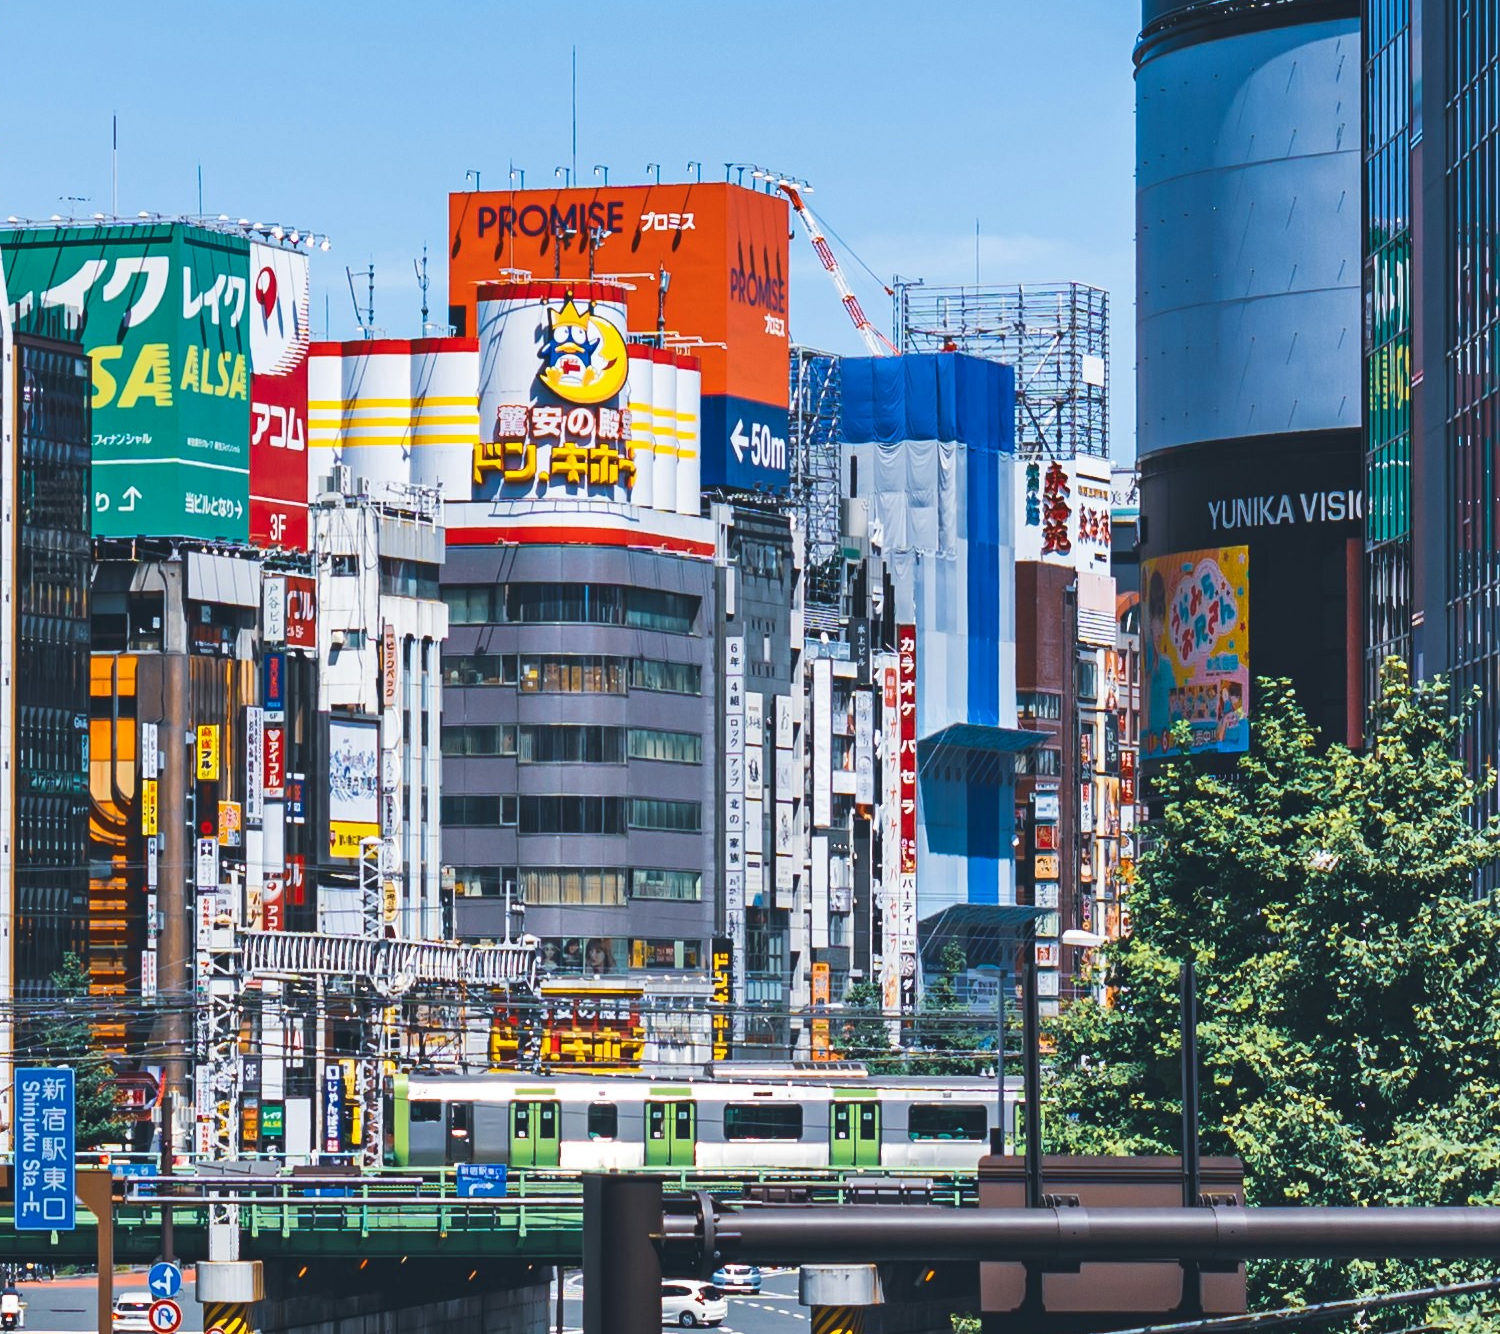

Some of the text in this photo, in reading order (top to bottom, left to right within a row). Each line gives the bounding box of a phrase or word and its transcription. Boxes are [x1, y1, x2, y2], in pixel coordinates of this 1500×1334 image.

[477, 201, 624, 239] PROMISE
[640, 210, 696, 232] プロミス
[182, 266, 247, 328] レイク
[730, 266, 786, 315] PROMISE
[764, 313, 786, 338] プロミス
[179, 344, 248, 401] ALSA
[251, 402, 305, 452] アコム
[497, 404, 634, 443] 驚安の殿堂
[751, 422, 786, 471] 50m
[184, 492, 236, 519] 当ビルとなり
[270, 512, 287, 541] 3F
[1207, 494, 1295, 529] YUNIKA
[729, 642, 741, 707] 6年 4組
[900, 636, 915, 717] カラオケ
[268, 741, 280, 787] アイフル
[729, 718, 740, 786] ロック アップ
[728, 798, 740, 864] 北の 家族
[21, 1080, 41, 1219] Shinjuku Sta.-E.
[41, 1077, 68, 1221] 新宿駅東口
